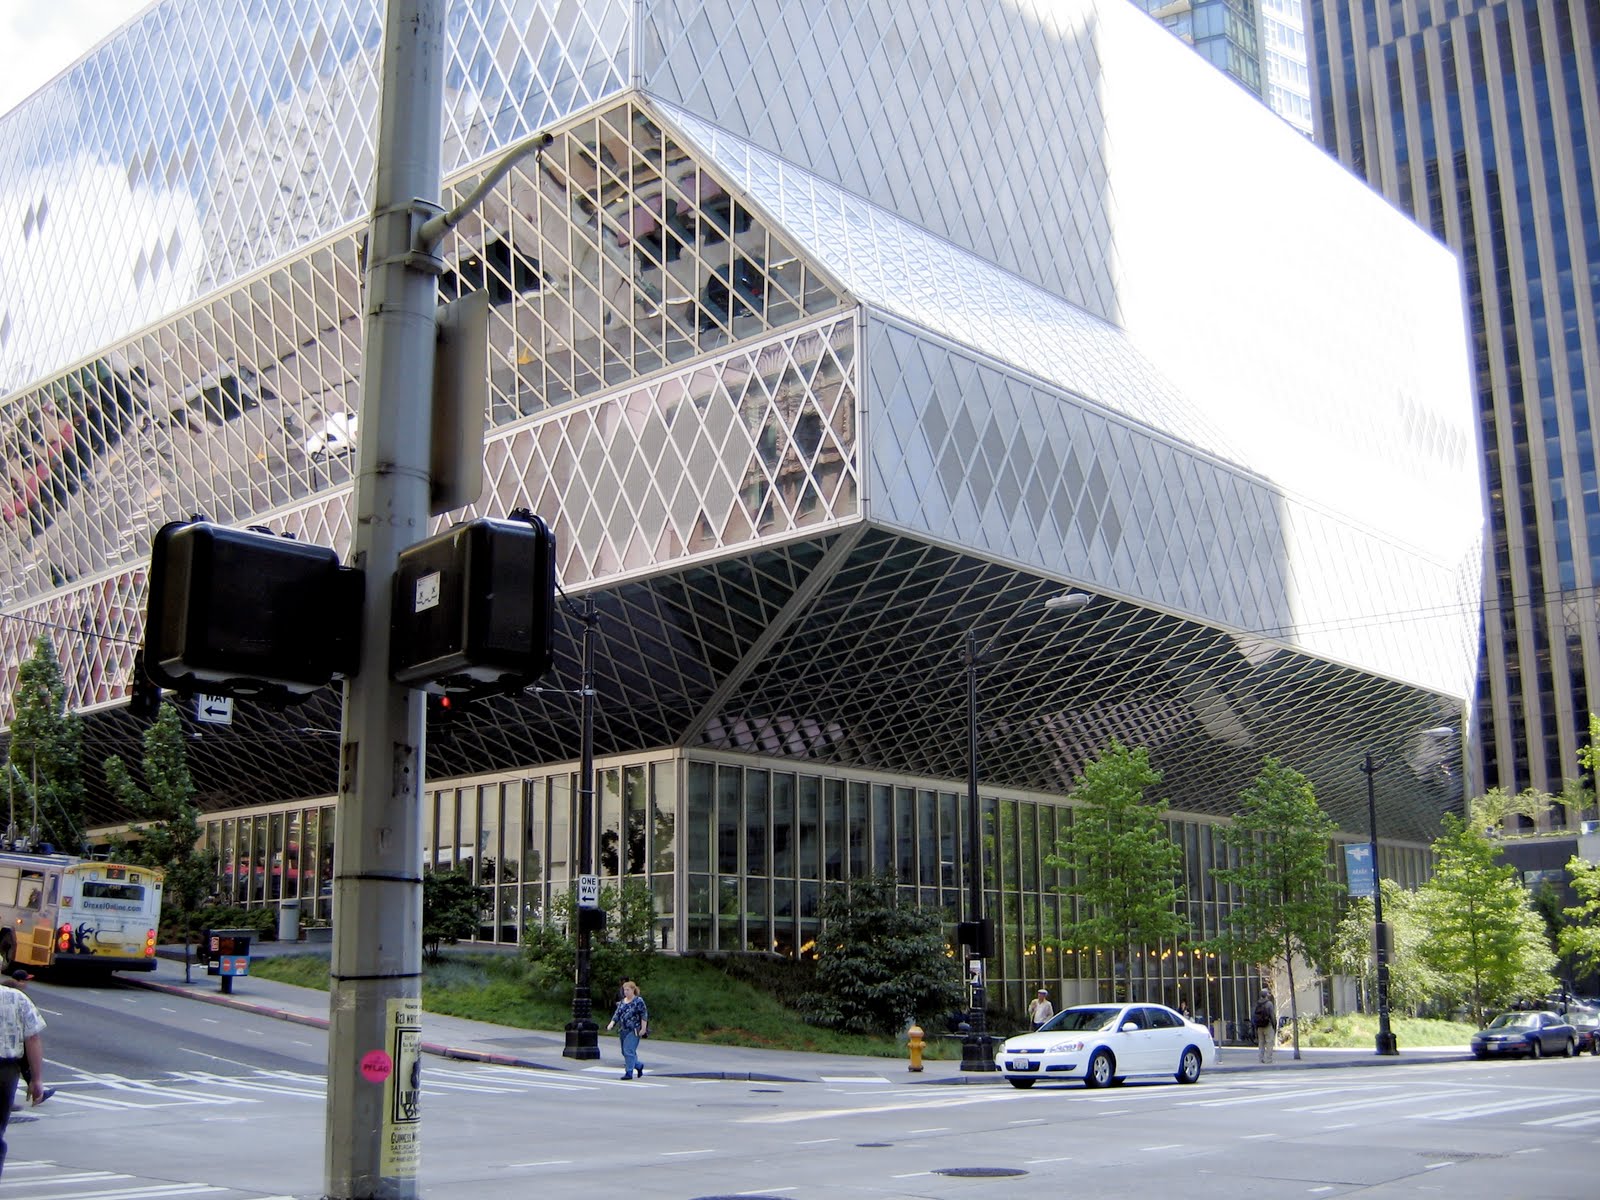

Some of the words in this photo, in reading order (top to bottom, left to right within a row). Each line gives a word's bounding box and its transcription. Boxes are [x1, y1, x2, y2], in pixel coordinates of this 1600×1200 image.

[112, 870, 119, 878] 2
[581, 877, 596, 885] ONE
[83, 901, 142, 912] DrexelOnline.com
